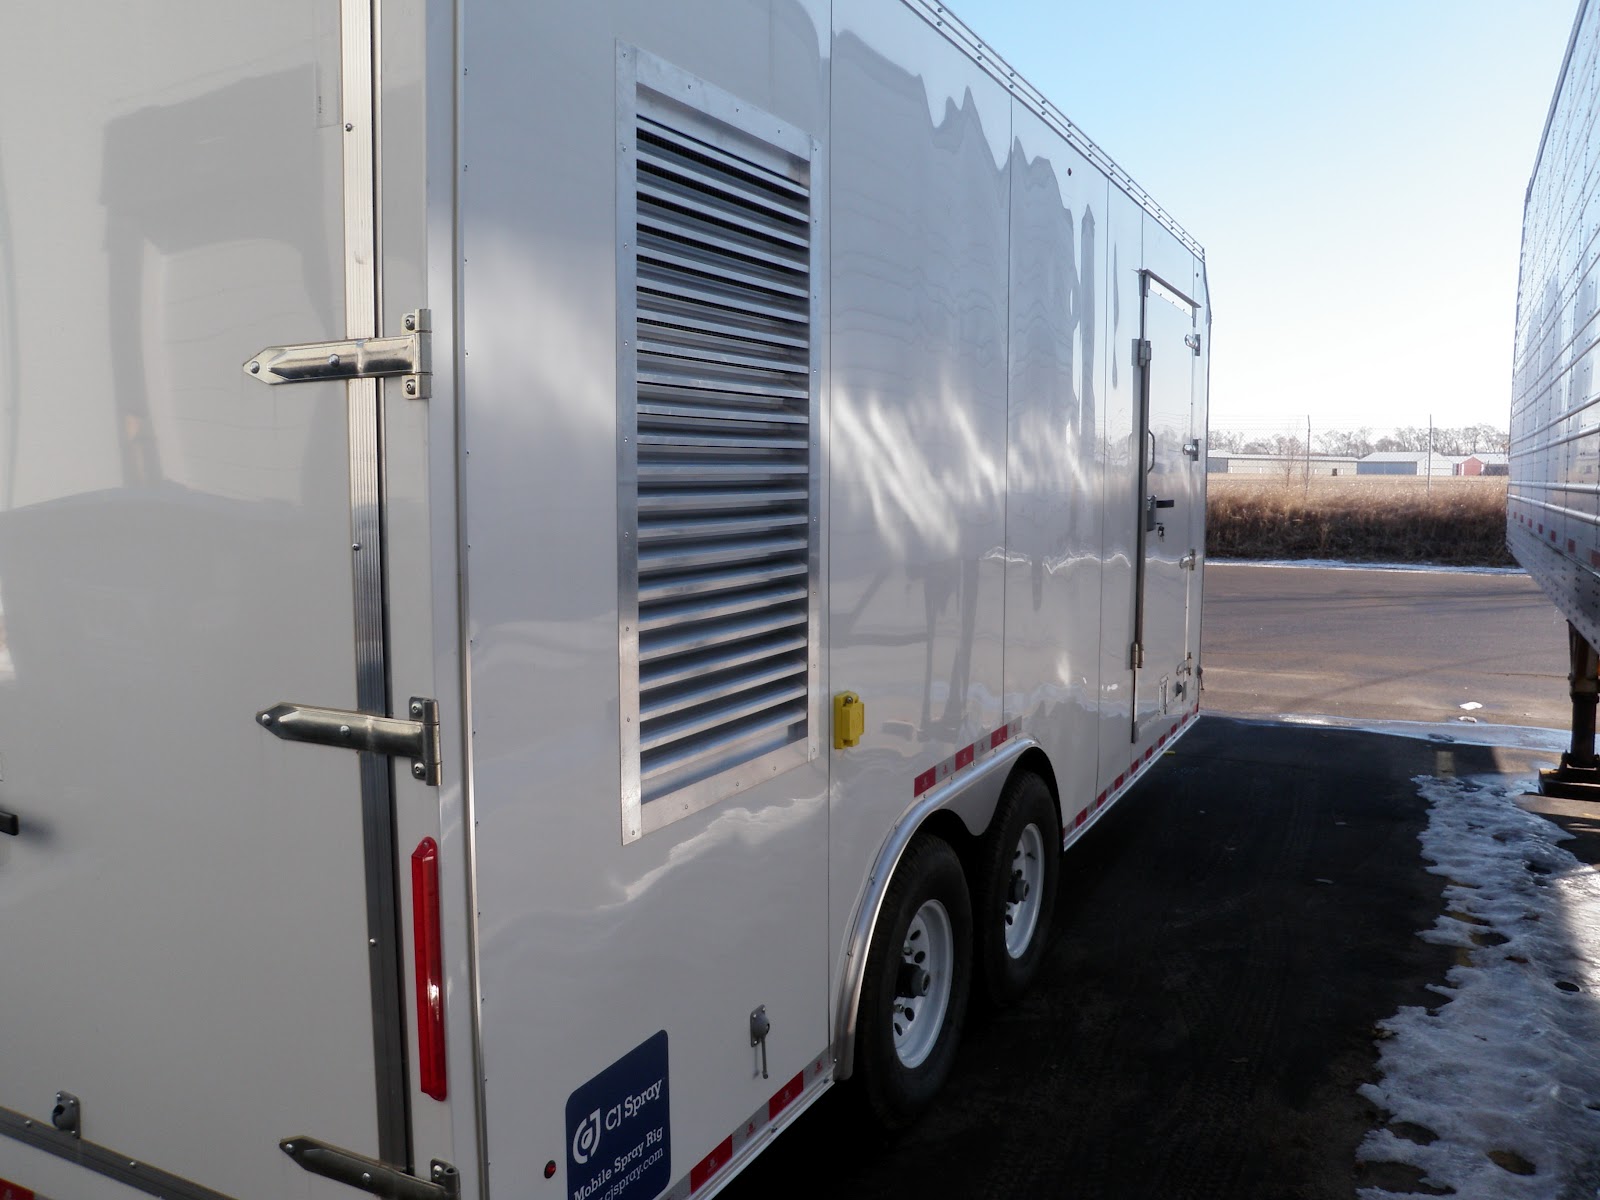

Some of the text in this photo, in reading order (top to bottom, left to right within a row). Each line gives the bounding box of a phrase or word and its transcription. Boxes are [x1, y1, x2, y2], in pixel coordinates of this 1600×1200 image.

[605, 1079, 663, 1130] CJ Spray
[574, 1127, 664, 1200] Mobile Spray Rig
[599, 1148, 664, 1200] cjspray.com
